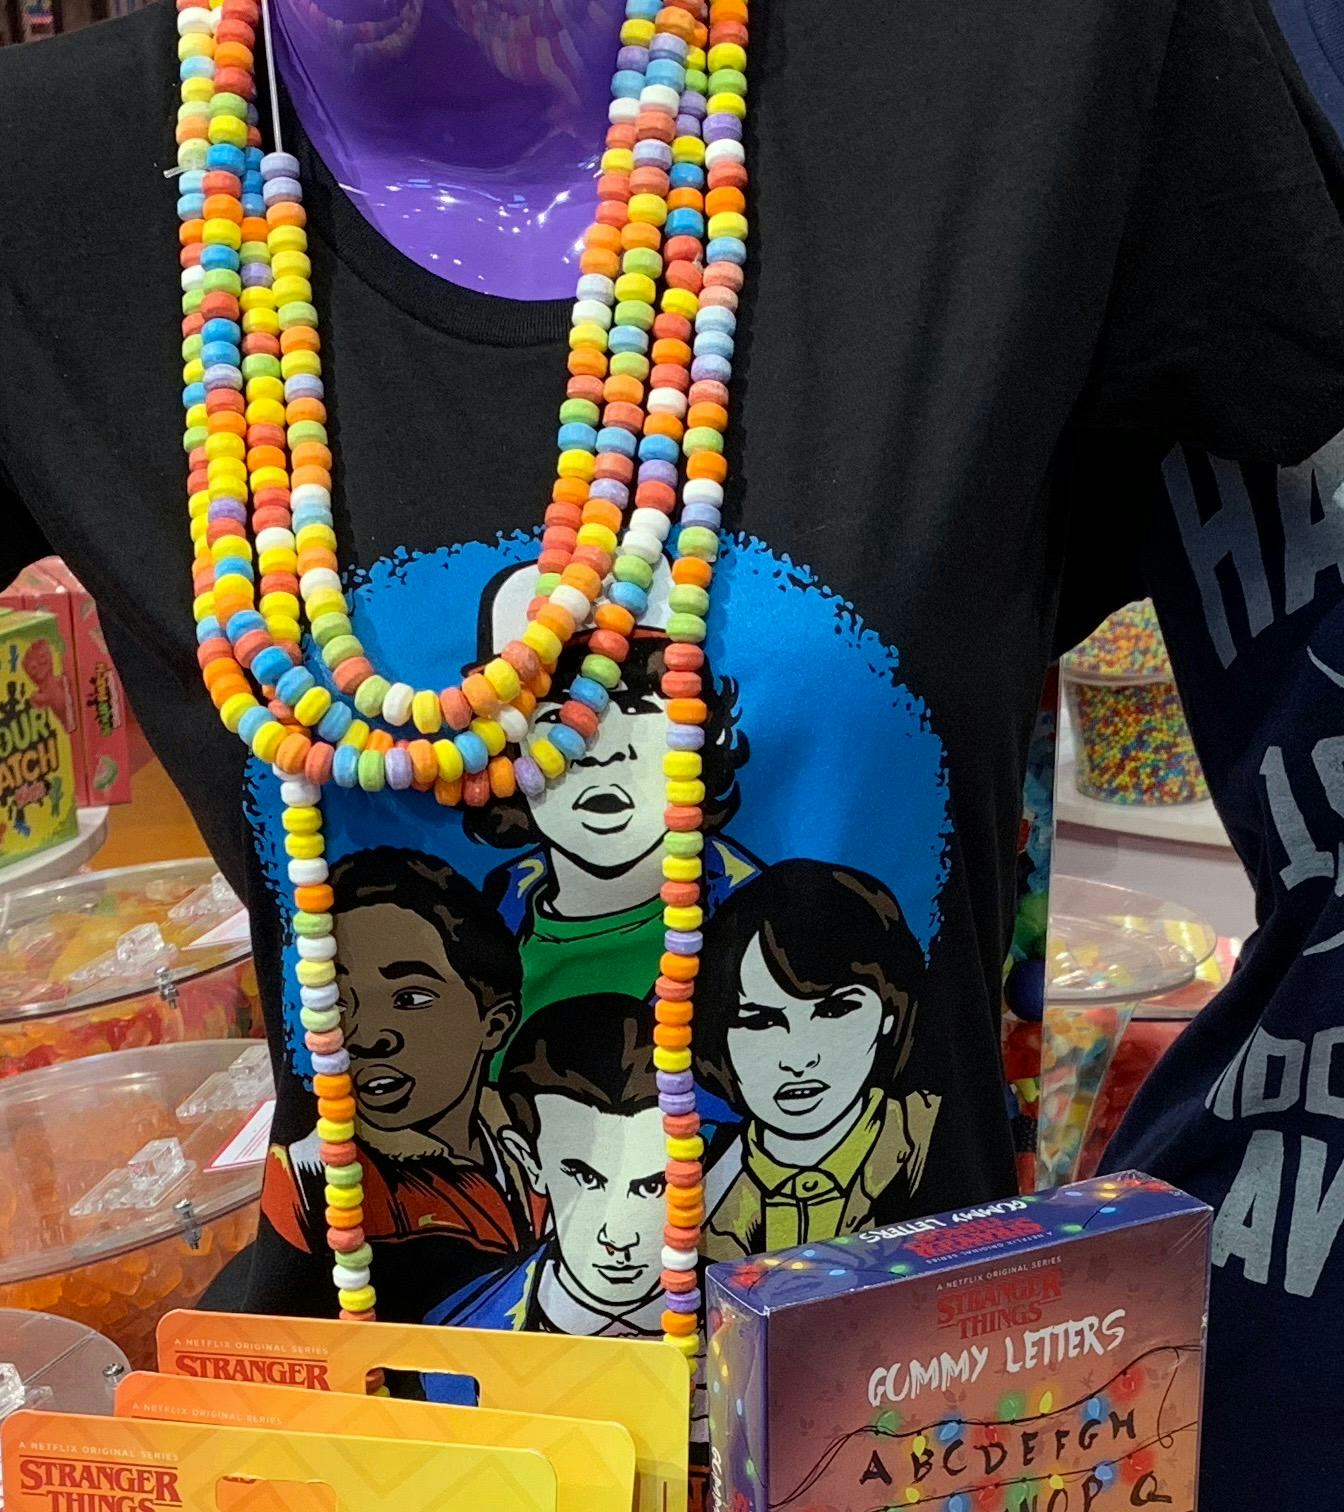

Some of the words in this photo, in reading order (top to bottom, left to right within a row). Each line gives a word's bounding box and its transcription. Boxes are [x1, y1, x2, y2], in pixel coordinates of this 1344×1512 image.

[937, 1282, 944, 1290] A
[946, 1274, 983, 1289] NETFLIX
[986, 1263, 1029, 1281] ORIGINAL
[1032, 1255, 1062, 1271] SERIES
[936, 1270, 1063, 1326] STRANGER
[957, 1302, 1042, 1340] THINGS
[175, 1354, 331, 1391] STRANGER
[867, 1344, 990, 1408] GUMMY
[1004, 1308, 1127, 1374] LETTERS
[30, 1442, 78, 1453] NETFLIX
[81, 1446, 136, 1457] ORIGINAL
[140, 1450, 179, 1461] SERIES
[20, 1459, 183, 1503] STRANGER
